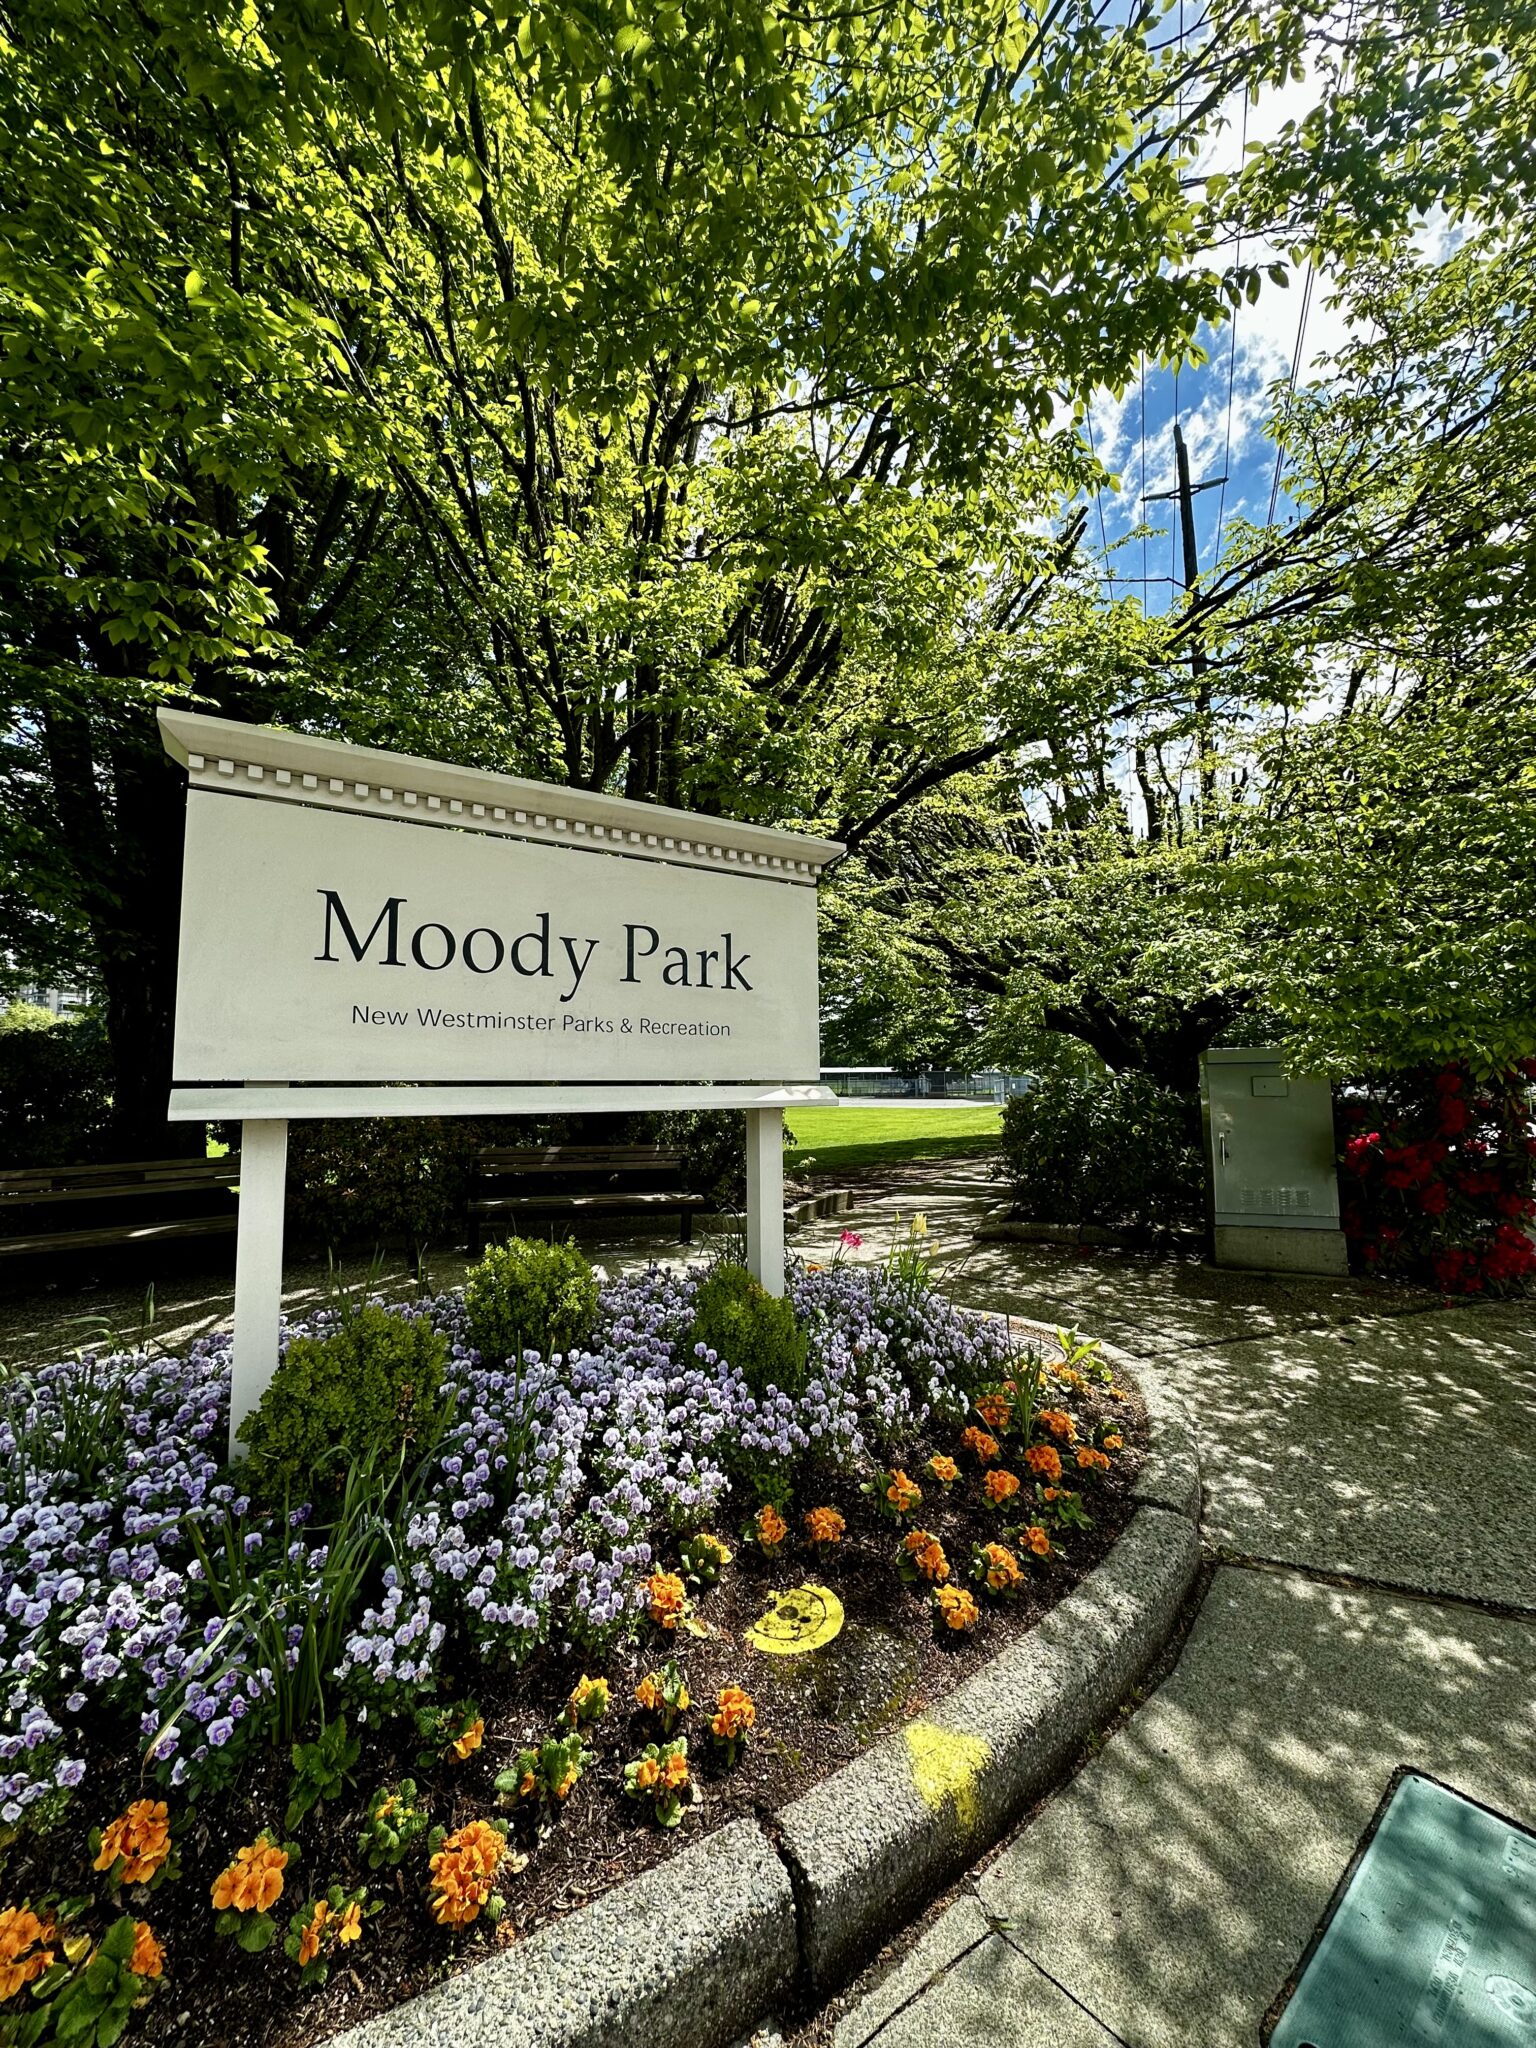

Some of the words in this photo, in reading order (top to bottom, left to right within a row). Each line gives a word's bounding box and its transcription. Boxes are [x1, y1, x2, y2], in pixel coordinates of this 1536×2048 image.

[314, 888, 600, 1003] Moody
[619, 923, 754, 992] Park
[352, 1004, 409, 1026] New
[416, 1007, 556, 1032] Westminster
[562, 1013, 614, 1034] Parks
[619, 1018, 634, 1035] &
[639, 1018, 731, 1037] Recreation
